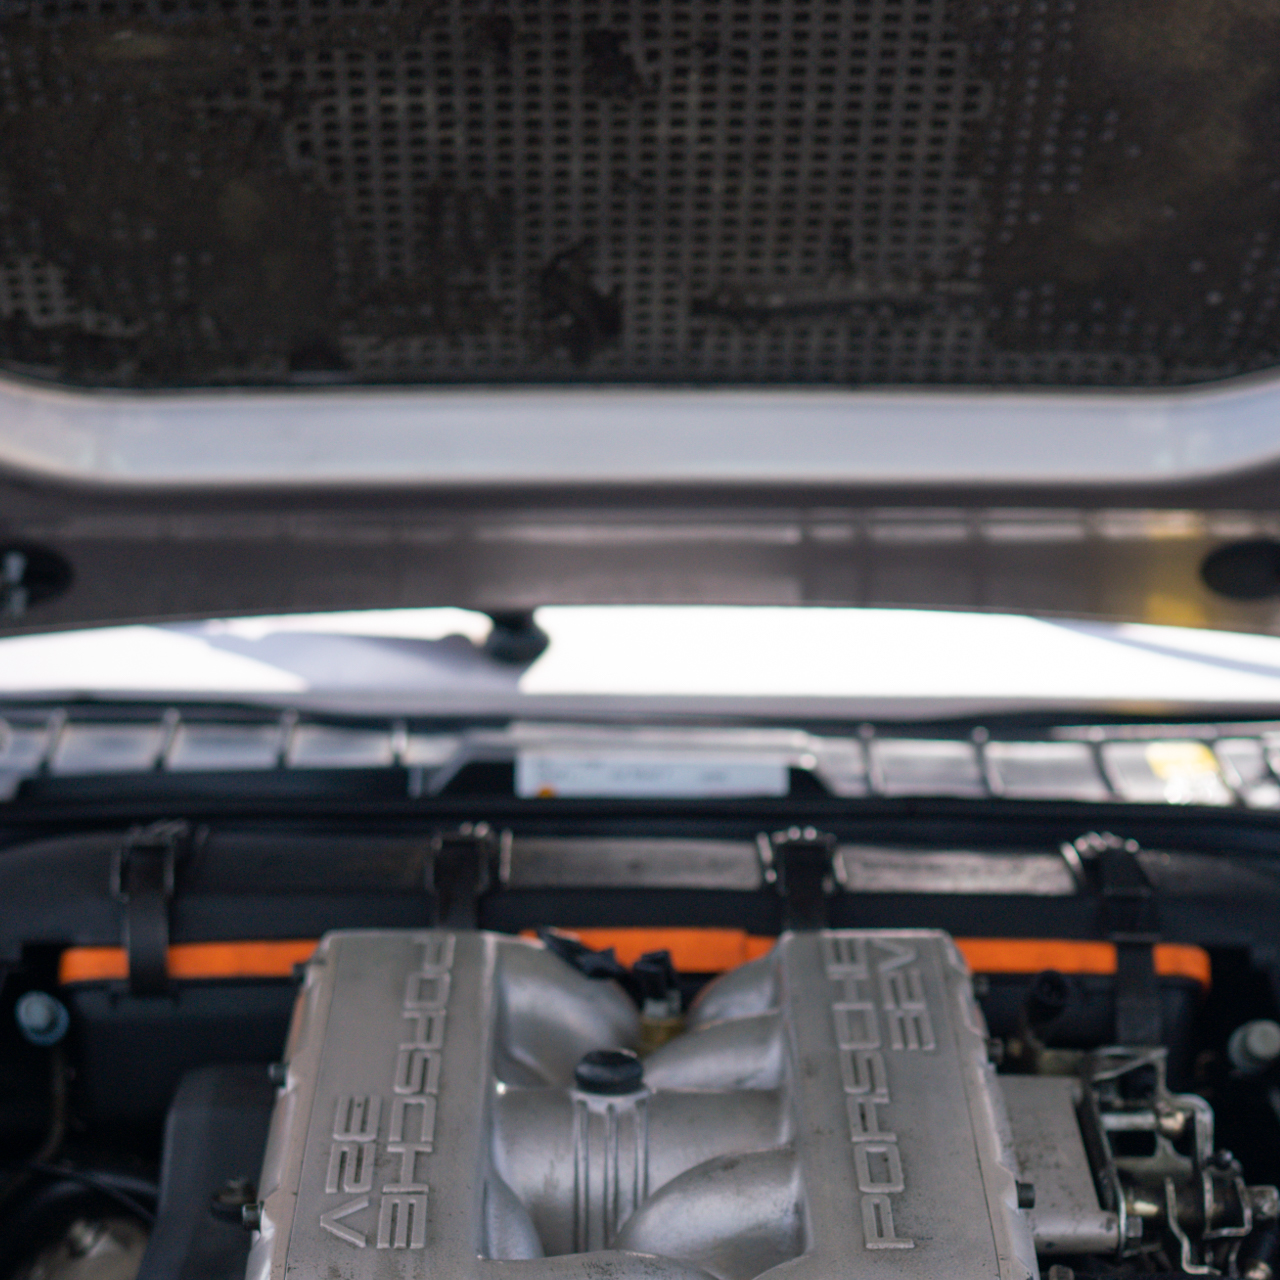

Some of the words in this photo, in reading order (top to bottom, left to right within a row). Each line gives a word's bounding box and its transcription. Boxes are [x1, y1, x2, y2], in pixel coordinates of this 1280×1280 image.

[377, 934, 456, 1249] PORSCHE
[826, 936, 915, 1249] PORSCHE
[877, 938, 936, 1050] 32V
[320, 1095, 382, 1247] 32V
